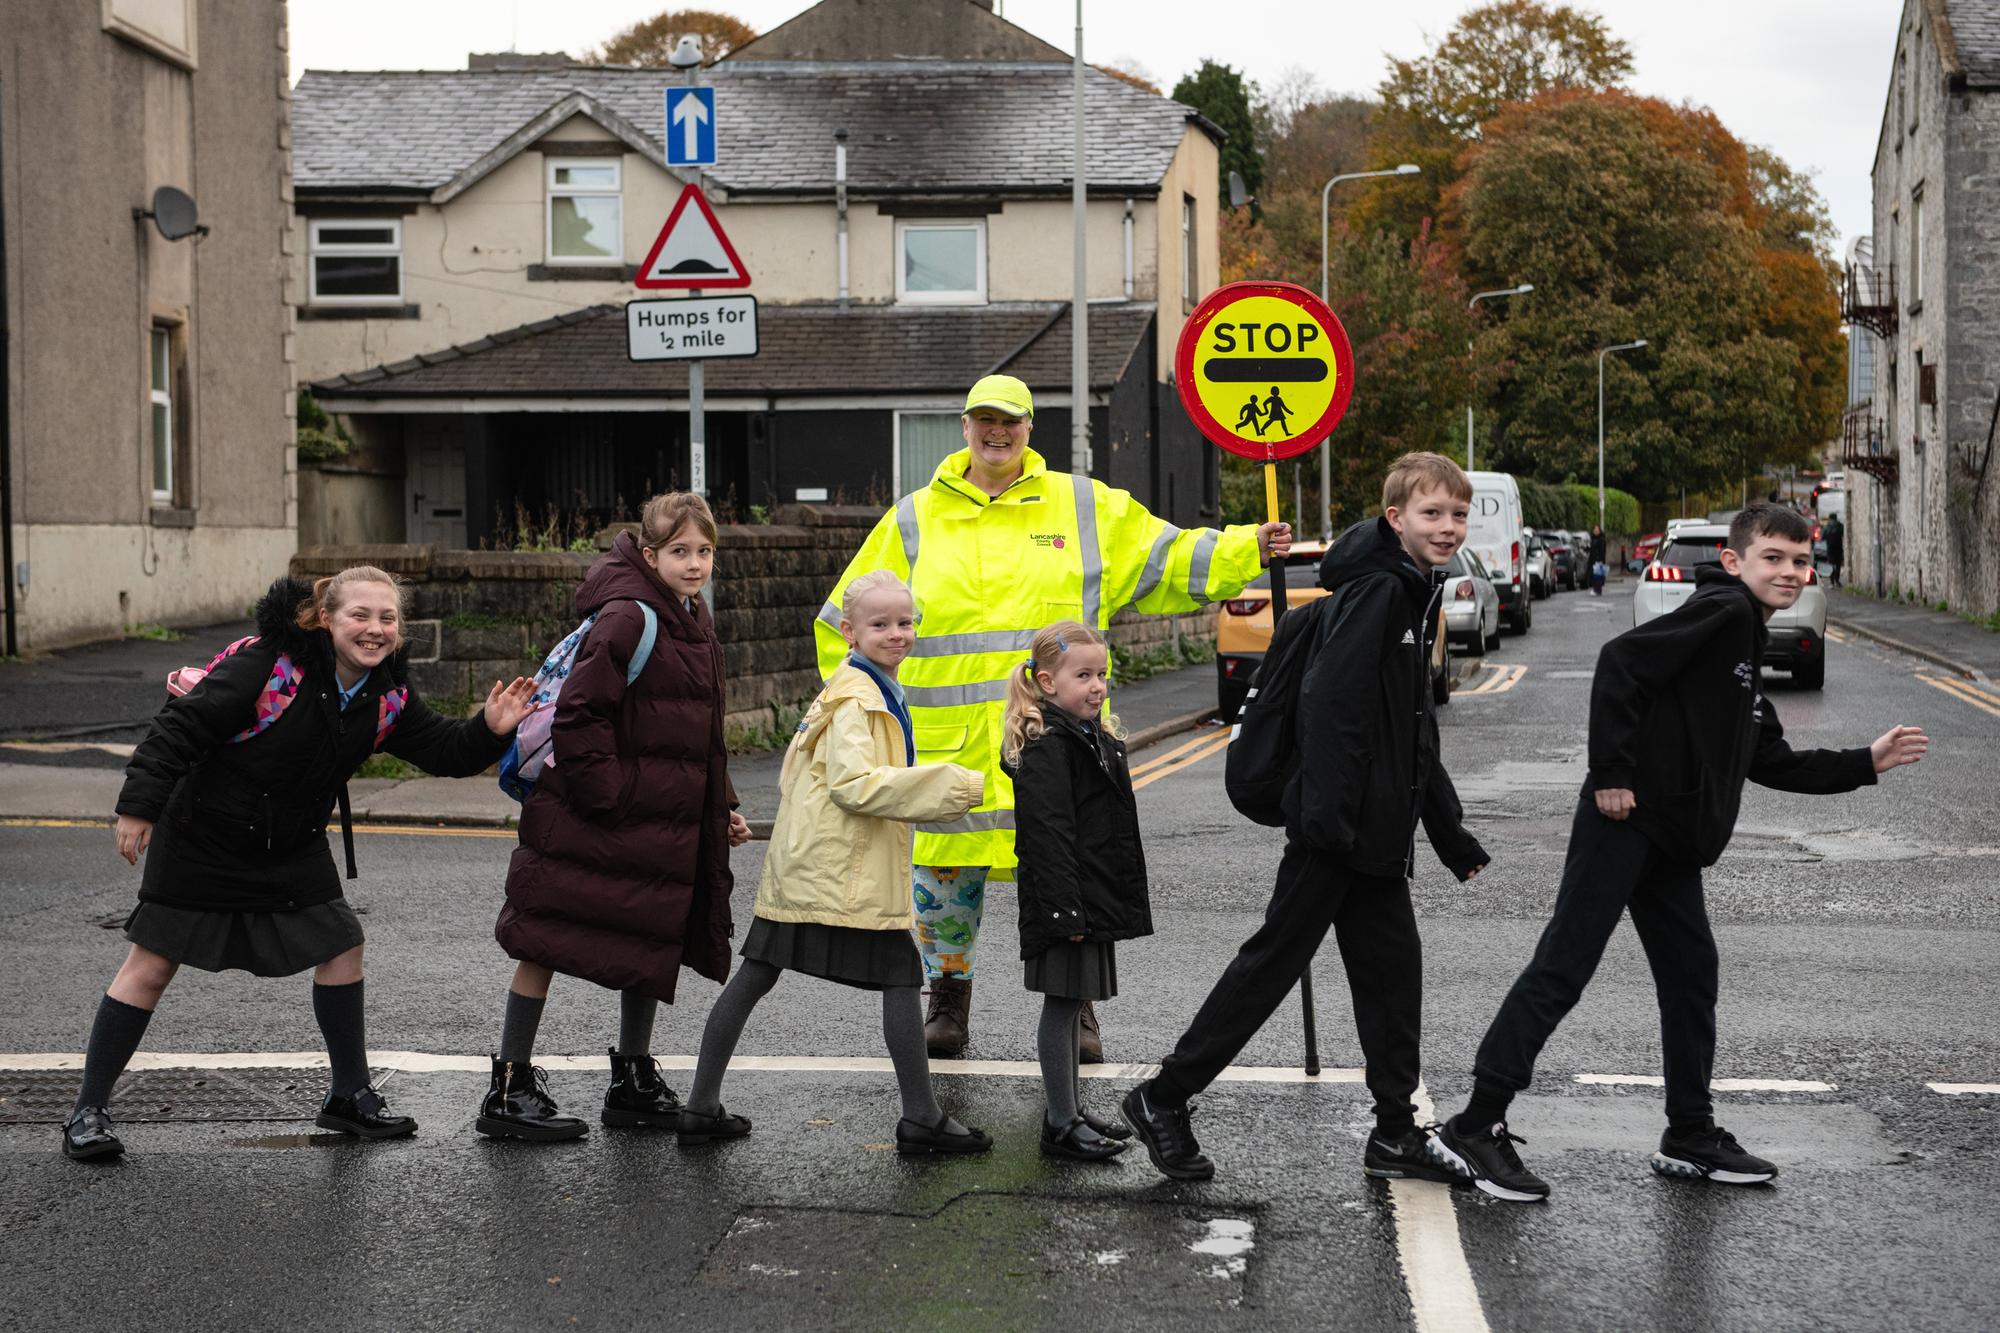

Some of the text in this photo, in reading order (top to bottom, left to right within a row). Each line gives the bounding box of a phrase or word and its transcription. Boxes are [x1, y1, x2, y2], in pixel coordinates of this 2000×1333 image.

[638, 306, 747, 328] Humps for
[682, 329, 725, 347] mile
[1212, 322, 1319, 353] STOP
